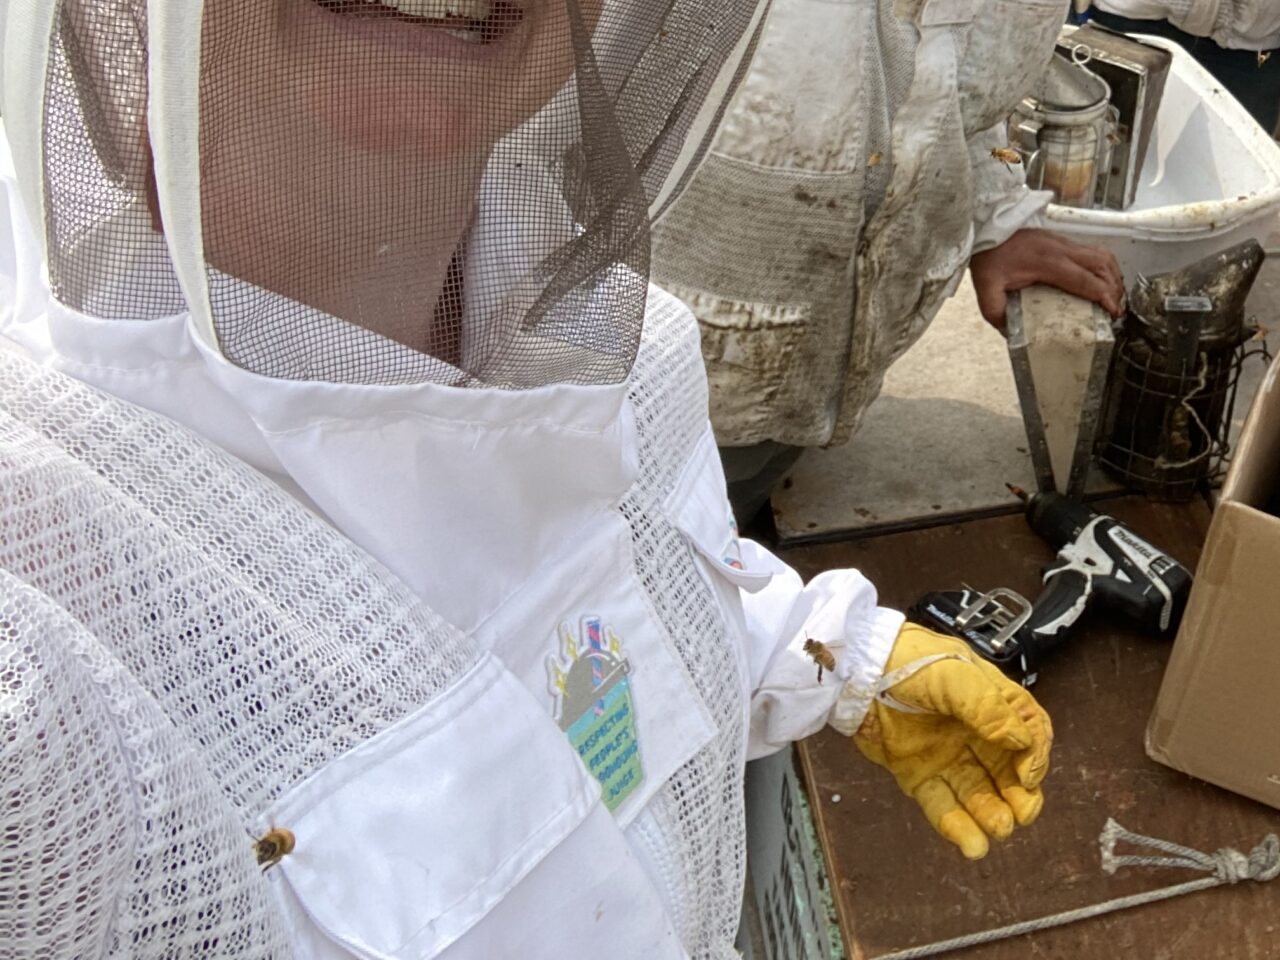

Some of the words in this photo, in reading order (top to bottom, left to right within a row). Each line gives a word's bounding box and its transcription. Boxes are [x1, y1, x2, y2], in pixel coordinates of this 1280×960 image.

[1114, 529, 1153, 559] Makita
[579, 703, 628, 755] RESPECTING
[589, 726, 629, 770] PEOPLE'S
[598, 739, 638, 784] RONOUNS
